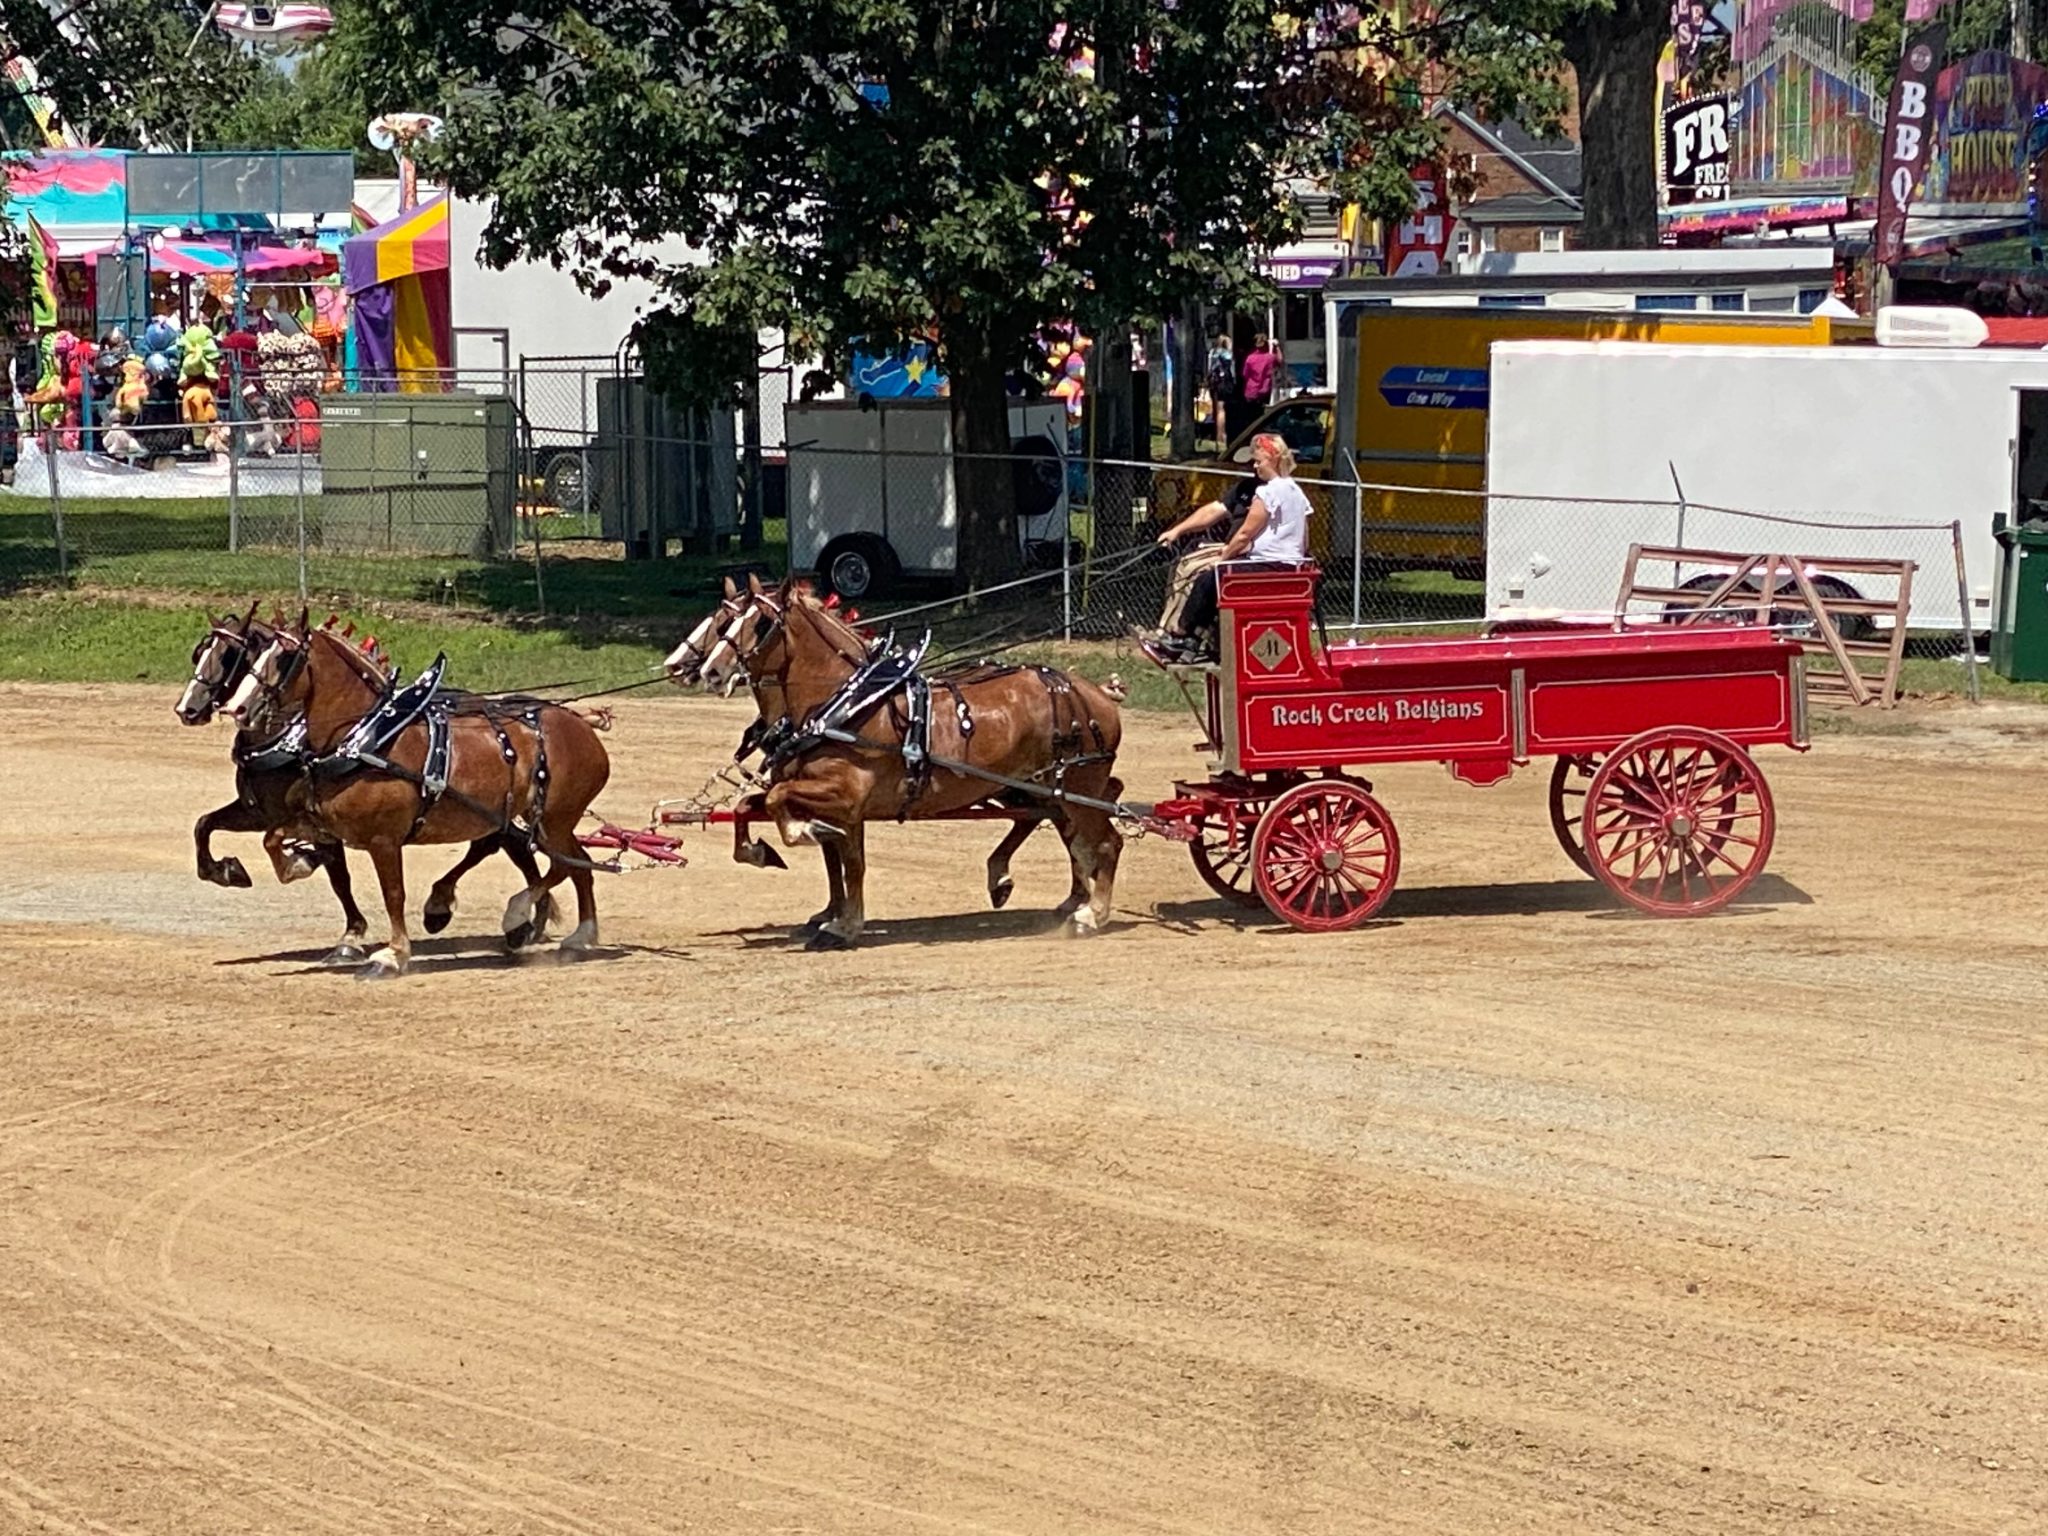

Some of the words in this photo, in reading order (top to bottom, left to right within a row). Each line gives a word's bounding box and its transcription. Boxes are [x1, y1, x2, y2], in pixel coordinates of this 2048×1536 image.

[1891, 81, 1927, 213] BBQ
[1951, 130, 2019, 173] HOUSE
[1416, 369, 1450, 383] Local
[1406, 391, 1429, 405] One
[1430, 392, 1457, 408] Way
[1271, 703, 1323, 727] Rock
[1327, 701, 1390, 724] Creek
[1394, 698, 1484, 724] Belgians
